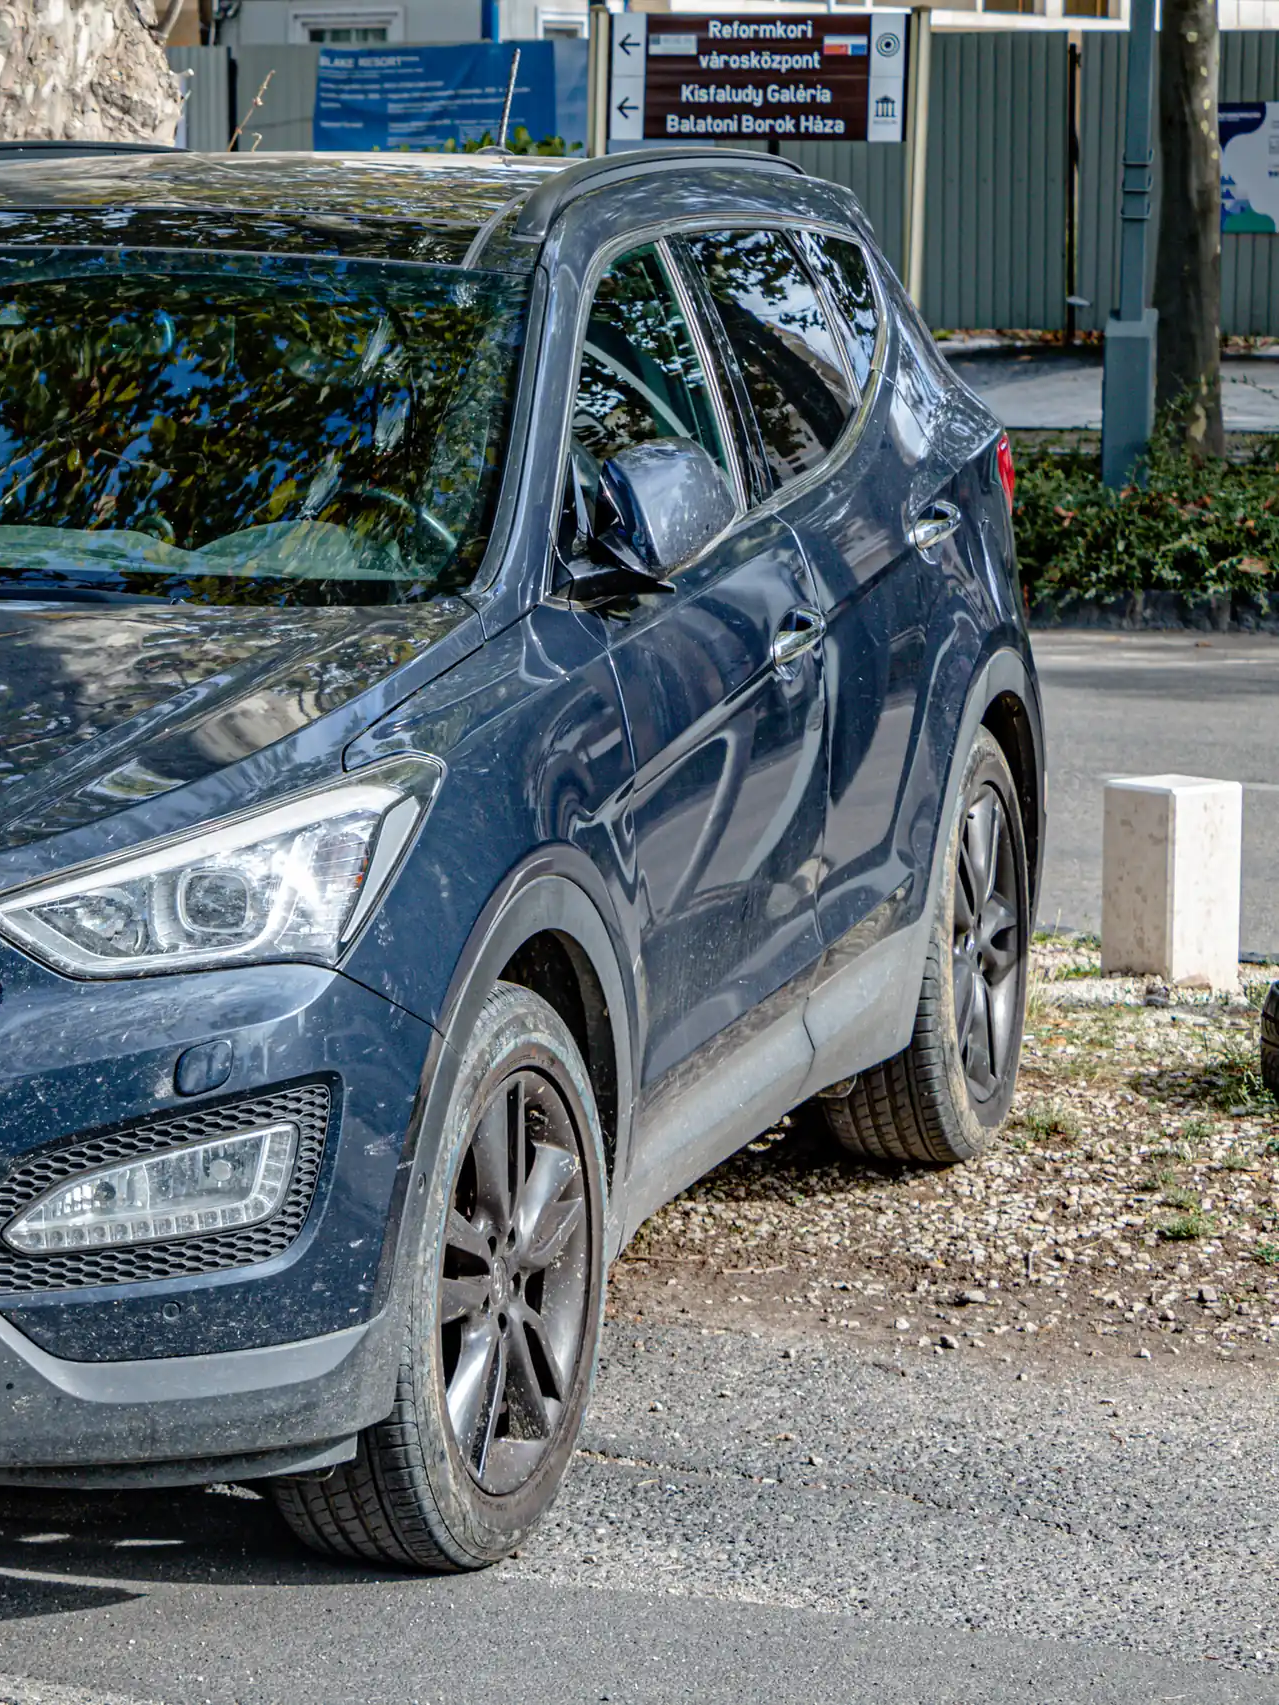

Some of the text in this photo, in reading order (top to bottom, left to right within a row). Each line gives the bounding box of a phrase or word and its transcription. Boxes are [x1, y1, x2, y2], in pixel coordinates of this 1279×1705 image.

[708, 19, 813, 39] Reformkori
[699, 50, 821, 74] városközpont
[681, 83, 832, 107] Kisfaludy Galéria
[666, 114, 846, 134] Balatoni Borok Háza
